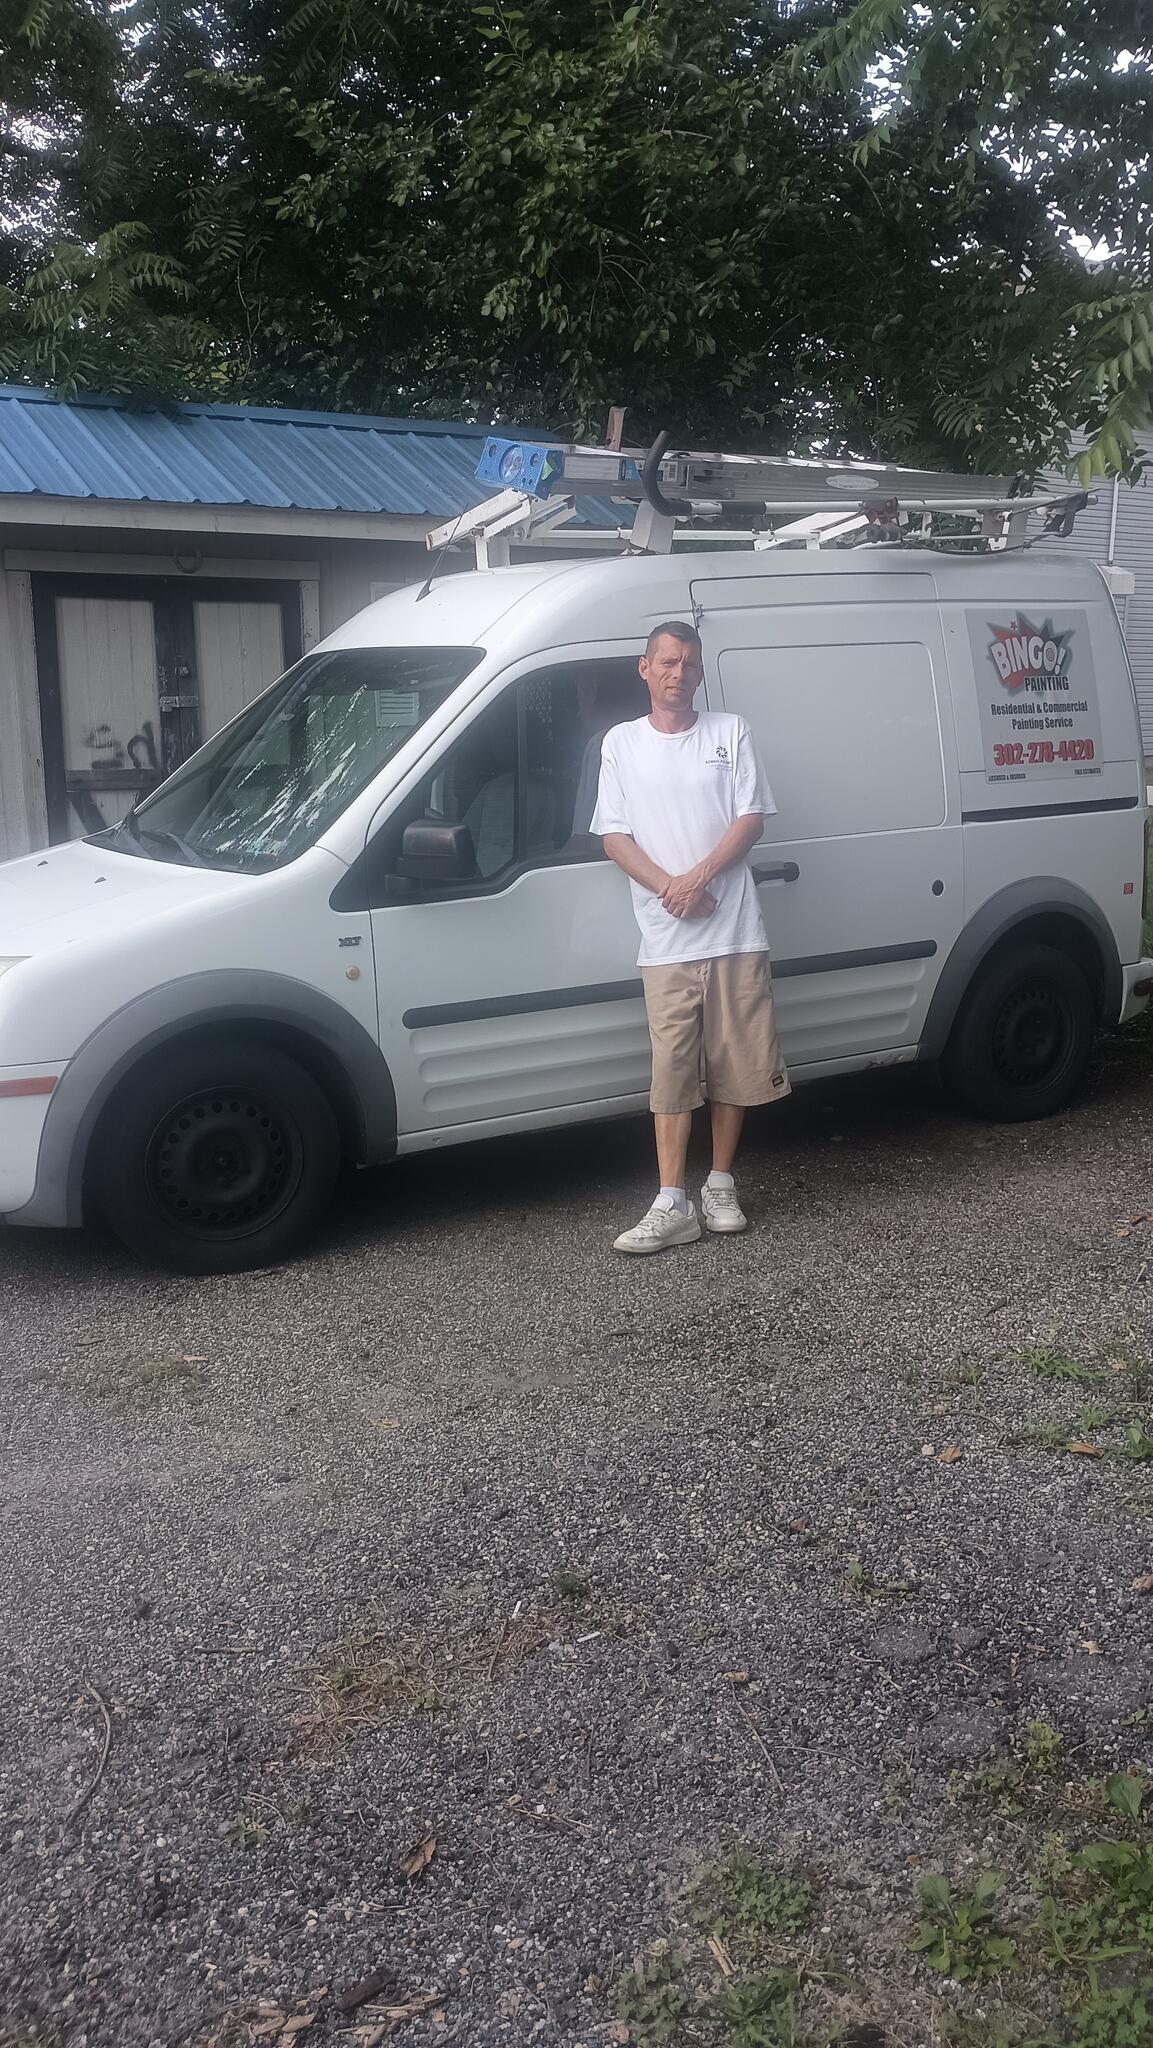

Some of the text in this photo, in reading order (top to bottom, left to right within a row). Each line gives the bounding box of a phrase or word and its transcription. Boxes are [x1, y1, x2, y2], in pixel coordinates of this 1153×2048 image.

[990, 636, 1066, 680] BINGO!
[1024, 676, 1069, 691] PAINTING
[991, 701, 1088, 715] Residential & Commercial
[1012, 717, 1073, 730] Painting Service
